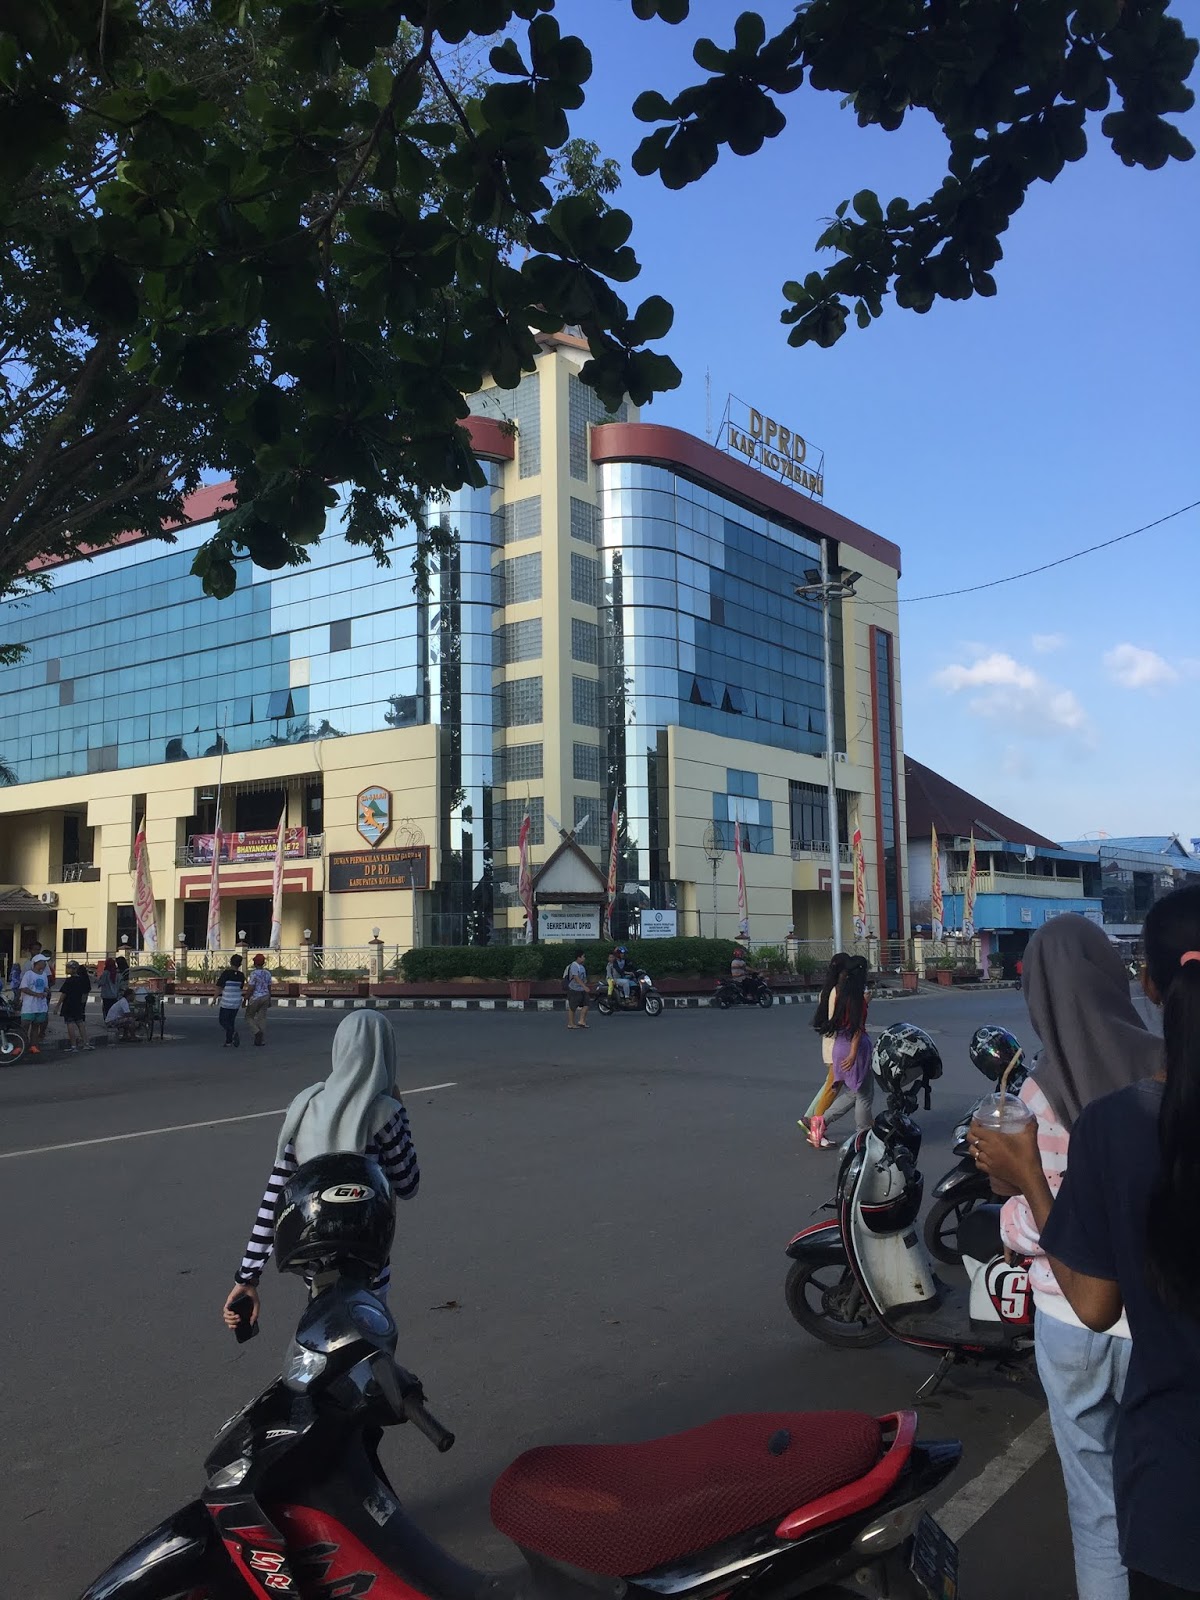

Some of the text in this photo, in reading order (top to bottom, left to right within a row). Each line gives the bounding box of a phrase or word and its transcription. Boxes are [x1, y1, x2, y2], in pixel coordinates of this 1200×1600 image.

[750, 407, 806, 464] DPRD
[237, 844, 277, 854] BHAYANGKAR
[292, 842, 300, 850] 72
[364, 864, 390, 876] DPRD
[546, 922, 592, 930] SEKRETARIAT DPRD
[334, 1187, 366, 1198] GM
